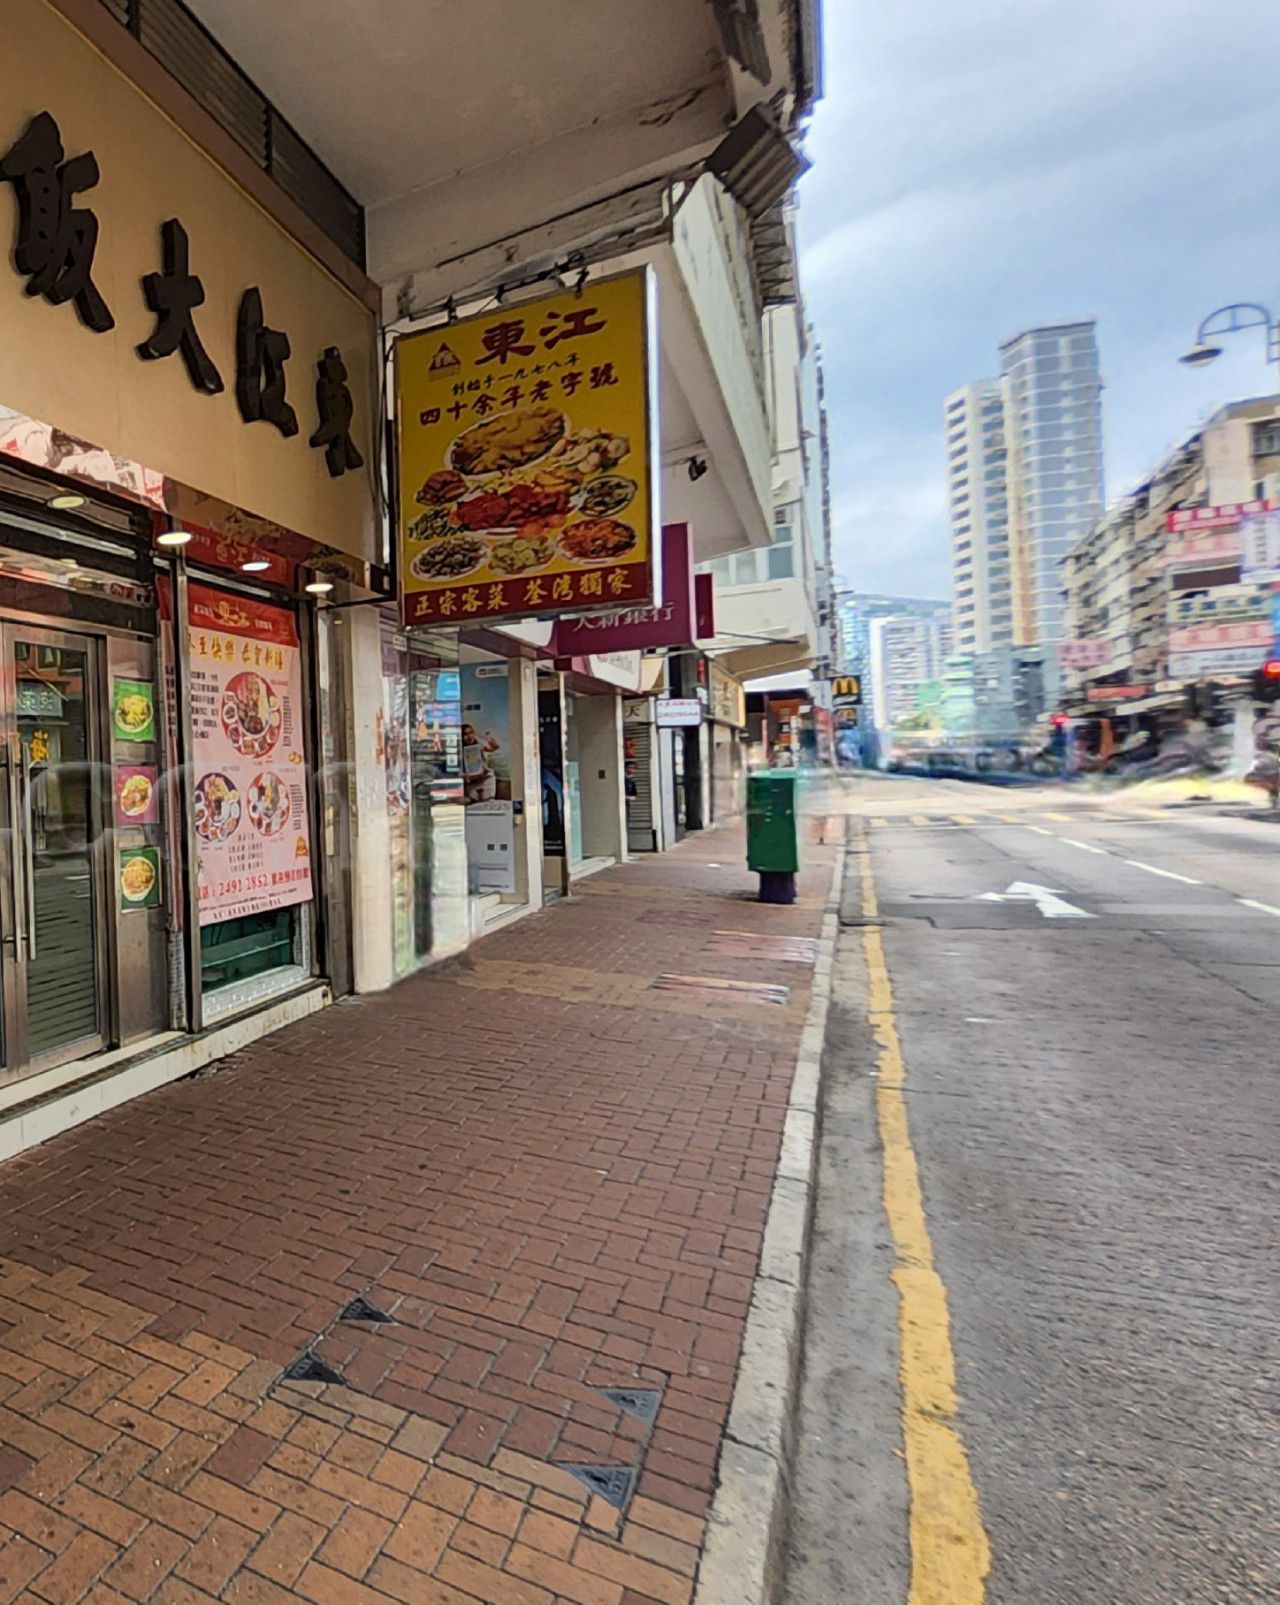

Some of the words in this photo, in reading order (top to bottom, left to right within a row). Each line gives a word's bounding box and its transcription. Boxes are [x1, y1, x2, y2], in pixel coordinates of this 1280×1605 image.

[474, 307, 608, 366] 東江
[413, 583, 509, 617] 正宗客菜
